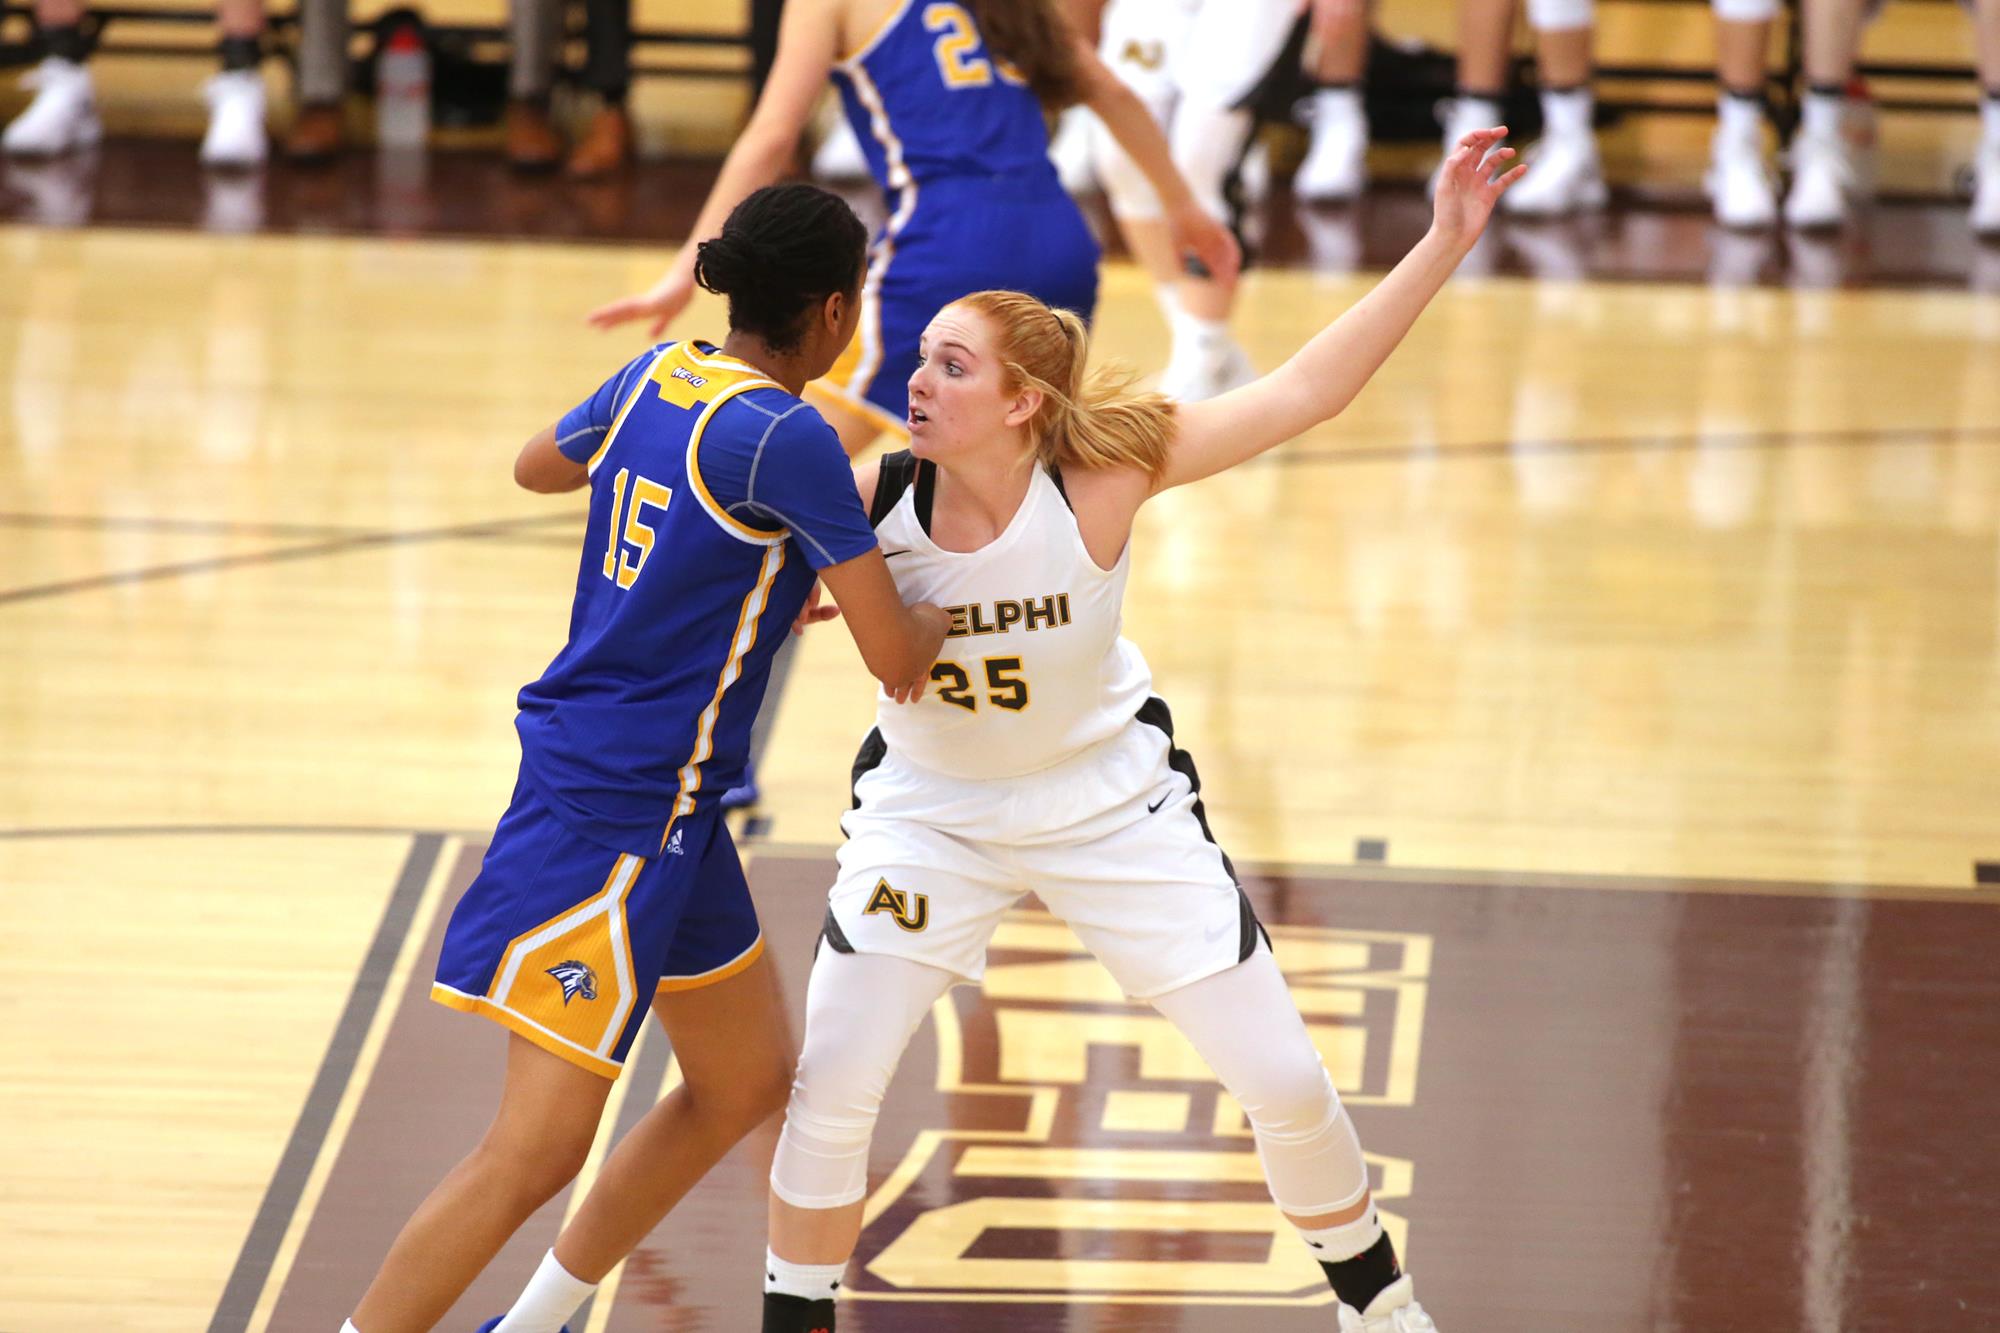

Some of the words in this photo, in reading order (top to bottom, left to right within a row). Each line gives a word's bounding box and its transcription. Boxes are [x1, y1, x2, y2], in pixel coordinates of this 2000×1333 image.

[922, 2, 1029, 88] 2
[602, 467, 673, 591] 15
[943, 592, 1072, 639] ELPHI
[929, 655, 1030, 714] 25
[862, 876, 929, 933] AU
